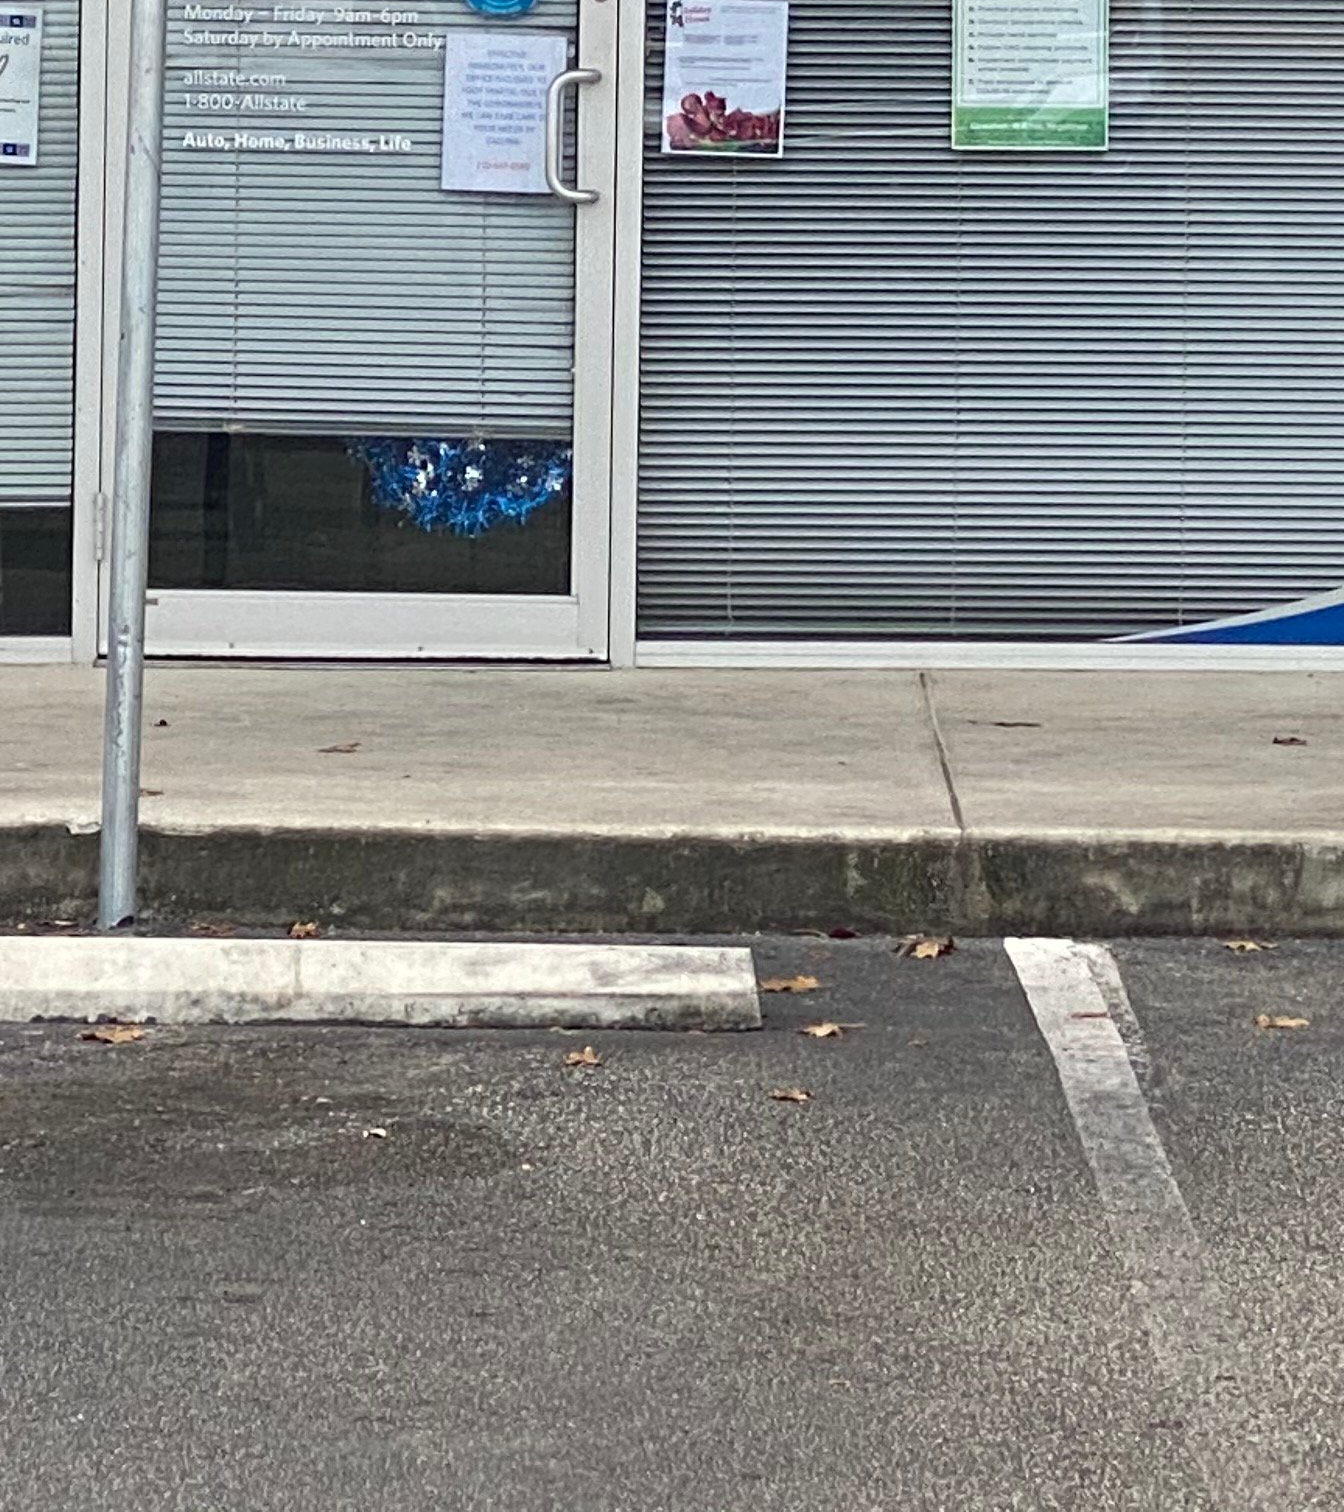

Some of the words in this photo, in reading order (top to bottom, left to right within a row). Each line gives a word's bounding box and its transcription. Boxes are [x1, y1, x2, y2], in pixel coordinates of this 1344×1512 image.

[183, 4, 254, 24] Monday
[272, 5, 325, 25] Friday
[333, 7, 420, 27] 9am-6pm
[183, 29, 259, 49] Saturday
[261, 31, 284, 49] by
[286, 30, 398, 50] Appointment
[401, 32, 444, 51] Only
[182, 70, 287, 87] allstate.com
[183, 93, 307, 111] 1-800-Allstate
[182, 131, 230, 151] Auto,
[233, 133, 291, 152] Home,
[294, 133, 375, 153] Business,
[378, 134, 412, 151] Life
